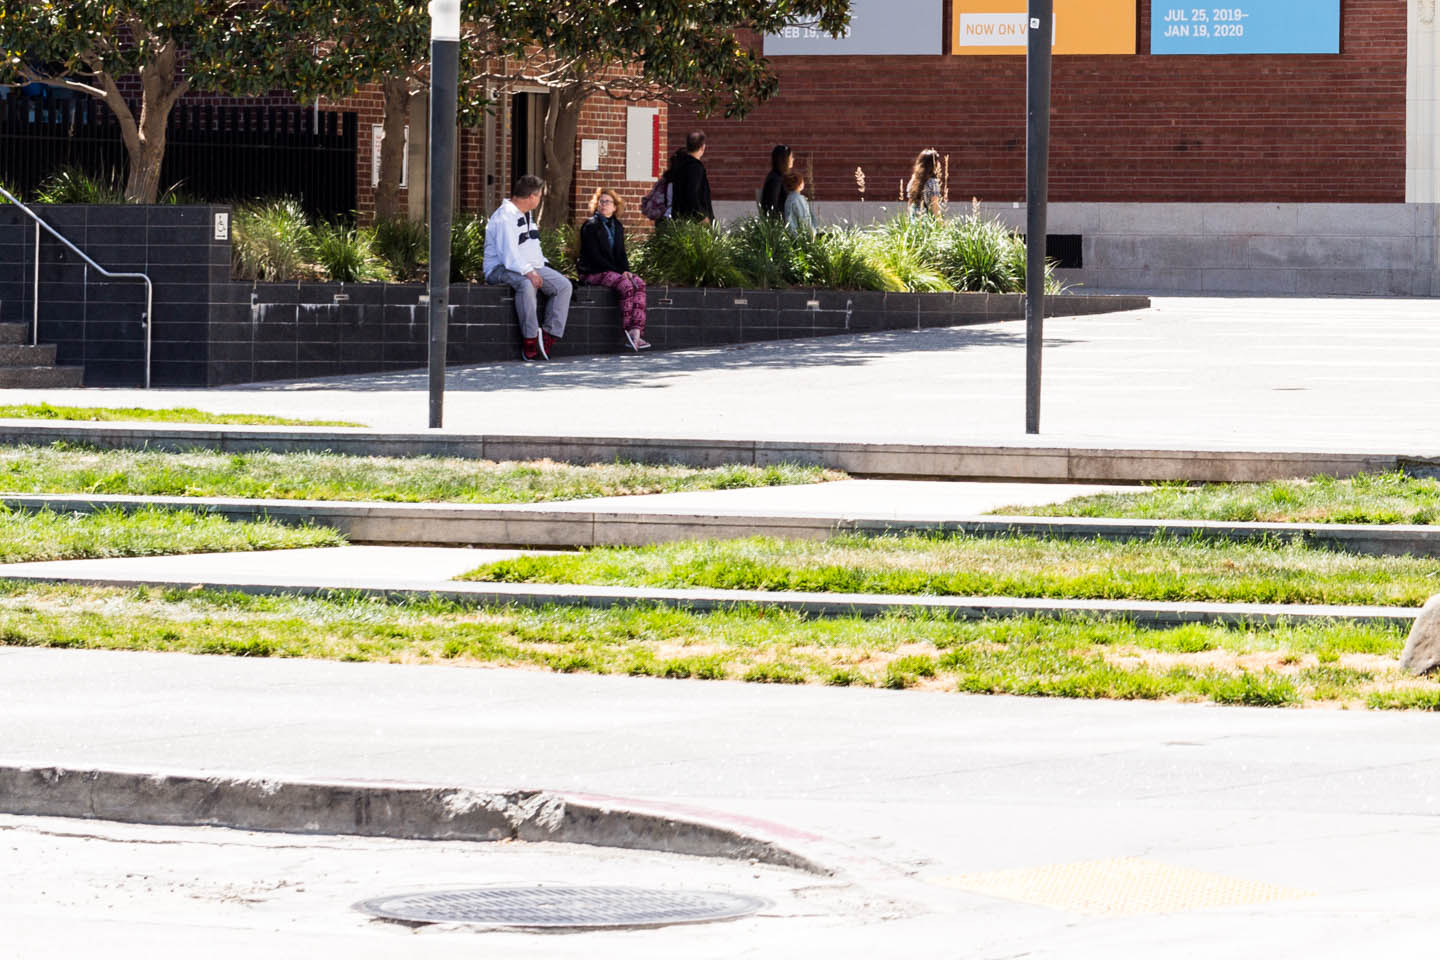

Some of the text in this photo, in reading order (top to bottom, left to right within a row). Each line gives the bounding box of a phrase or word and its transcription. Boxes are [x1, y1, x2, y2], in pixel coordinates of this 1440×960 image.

[1164, 9, 1188, 22] JUL
[1191, 8, 1209, 23] 25,
[966, 24, 995, 36] NOW
[998, 23, 1016, 36] ON
[1164, 24, 1244, 38] JAN 19, 2020
